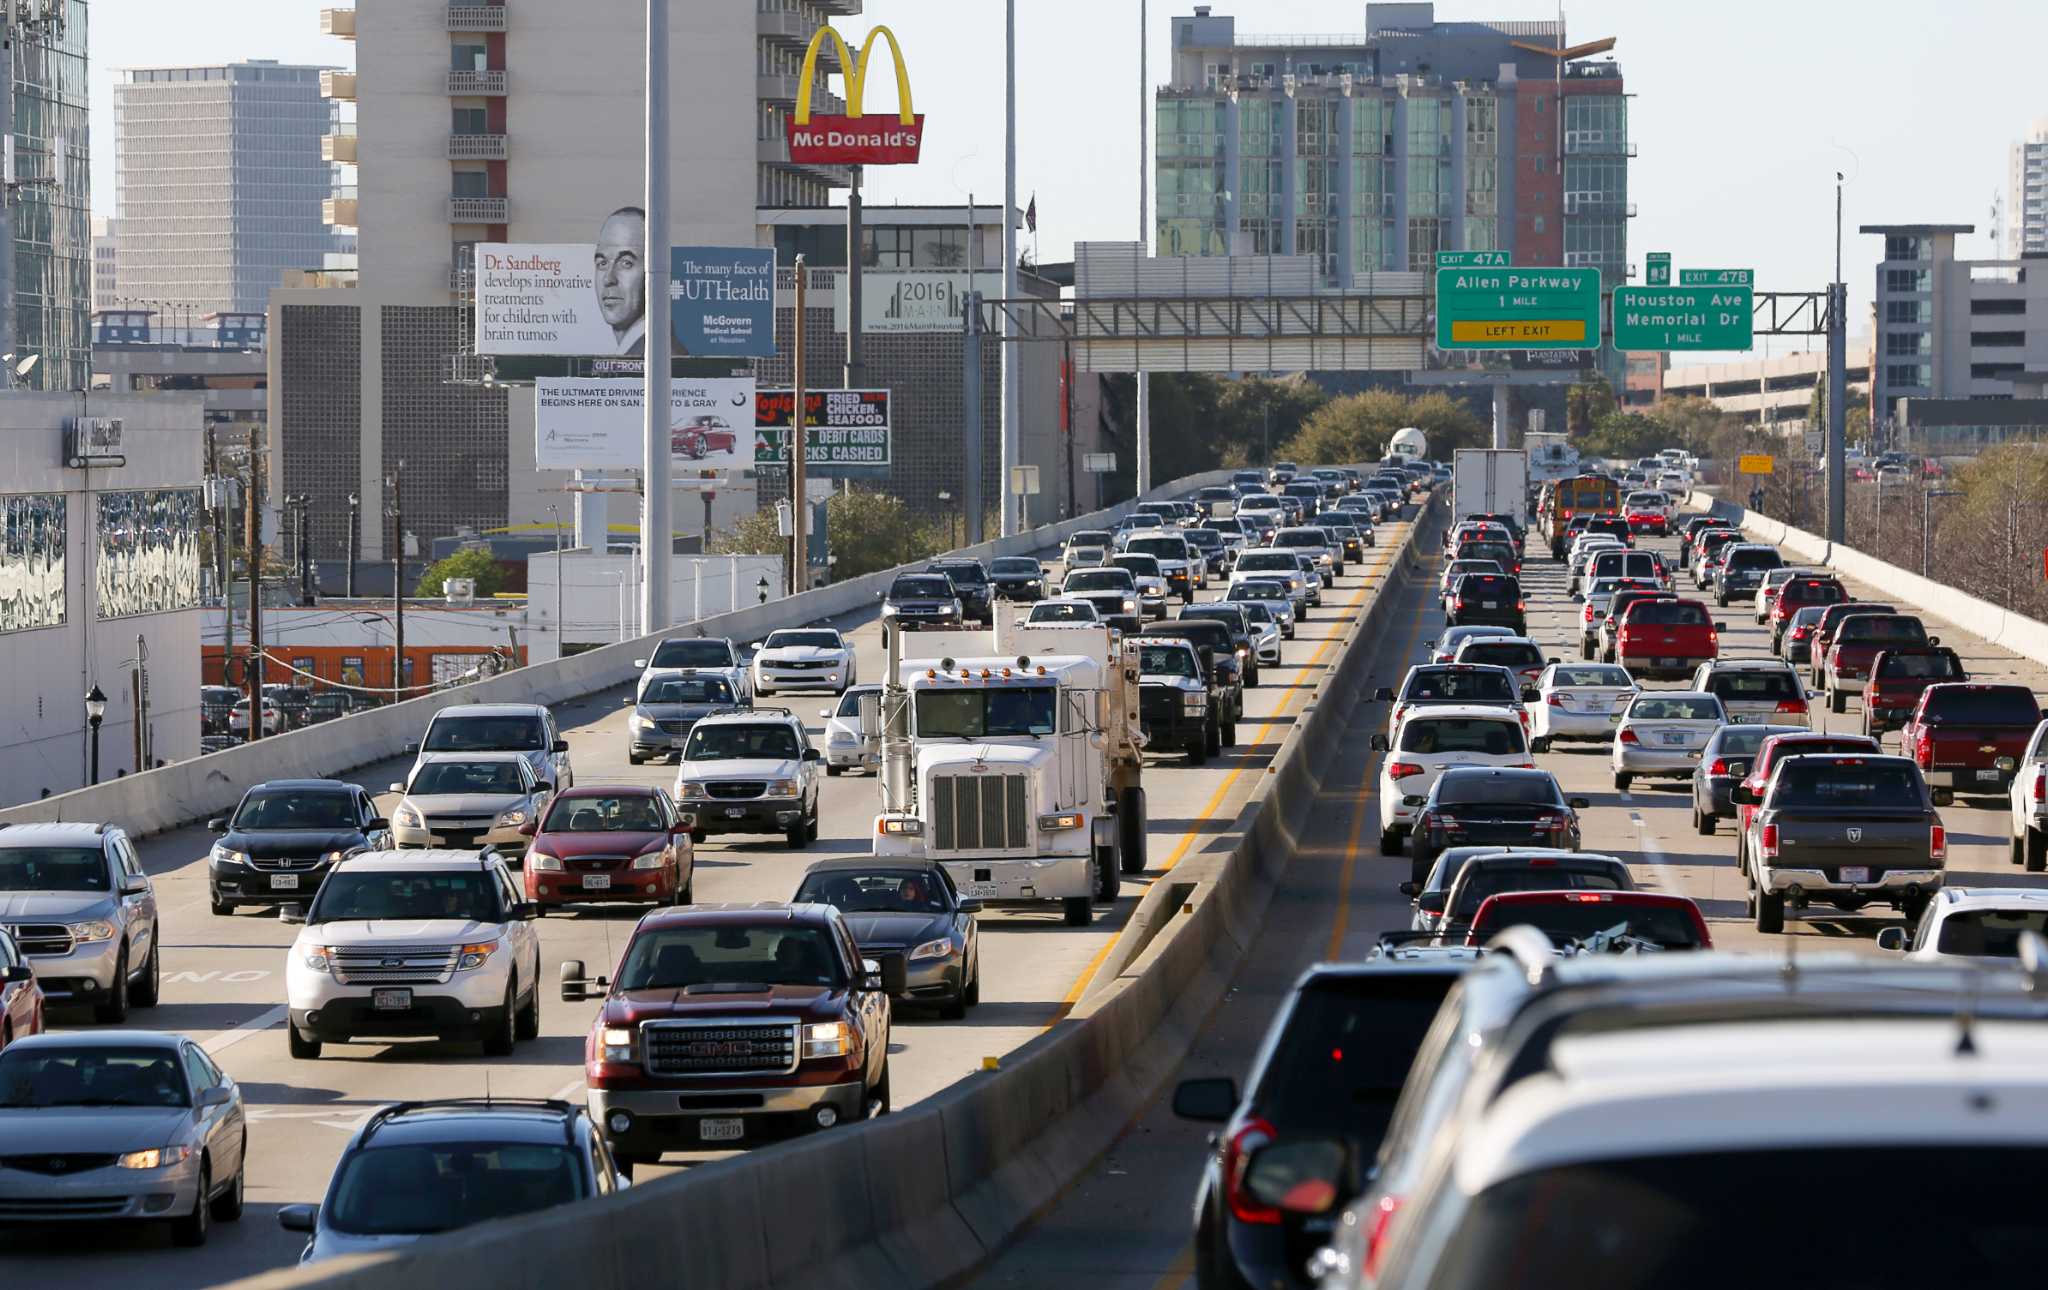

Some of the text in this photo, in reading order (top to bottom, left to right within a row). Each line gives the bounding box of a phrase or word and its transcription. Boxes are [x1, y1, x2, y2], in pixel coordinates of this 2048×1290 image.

[793, 131, 917, 147] McDonald's
[1440, 253, 1505, 265] EXIT 47A
[484, 255, 561, 276] Dr. Sandberg
[683, 260, 771, 278] The many faces of
[484, 272, 592, 291] develops innovative
[1455, 275, 1582, 291] Allen Parkway
[1685, 271, 1748, 283] EXIT 47B
[903, 282, 945, 301] 2016
[484, 293, 544, 305] treatments
[1499, 296, 1538, 307] 1 MILE
[1624, 294, 1742, 306] Houston Ave
[484, 307, 577, 324] for children with
[703, 315, 752, 325] McGovern
[1626, 313, 1739, 326] Memorial Dr
[484, 327, 558, 341] brain tumors
[1486, 325, 1551, 336] LEFT EXIT
[1664, 333, 1702, 344] 1 MILE
[541, 388, 560, 397] THE
[561, 388, 607, 397] ULTIMATE
[826, 393, 861, 404] FRIED
[541, 399, 576, 407] BEGINS
[577, 399, 602, 407] HERE
[604, 399, 618, 407] ON
[620, 399, 640, 407] SAN
[692, 400, 717, 408] GRAY
[827, 414, 884, 425] SEAFOOD
[819, 430, 848, 444] DEBIT
[850, 430, 885, 444] CARDS
[832, 447, 883, 460] CASHED
